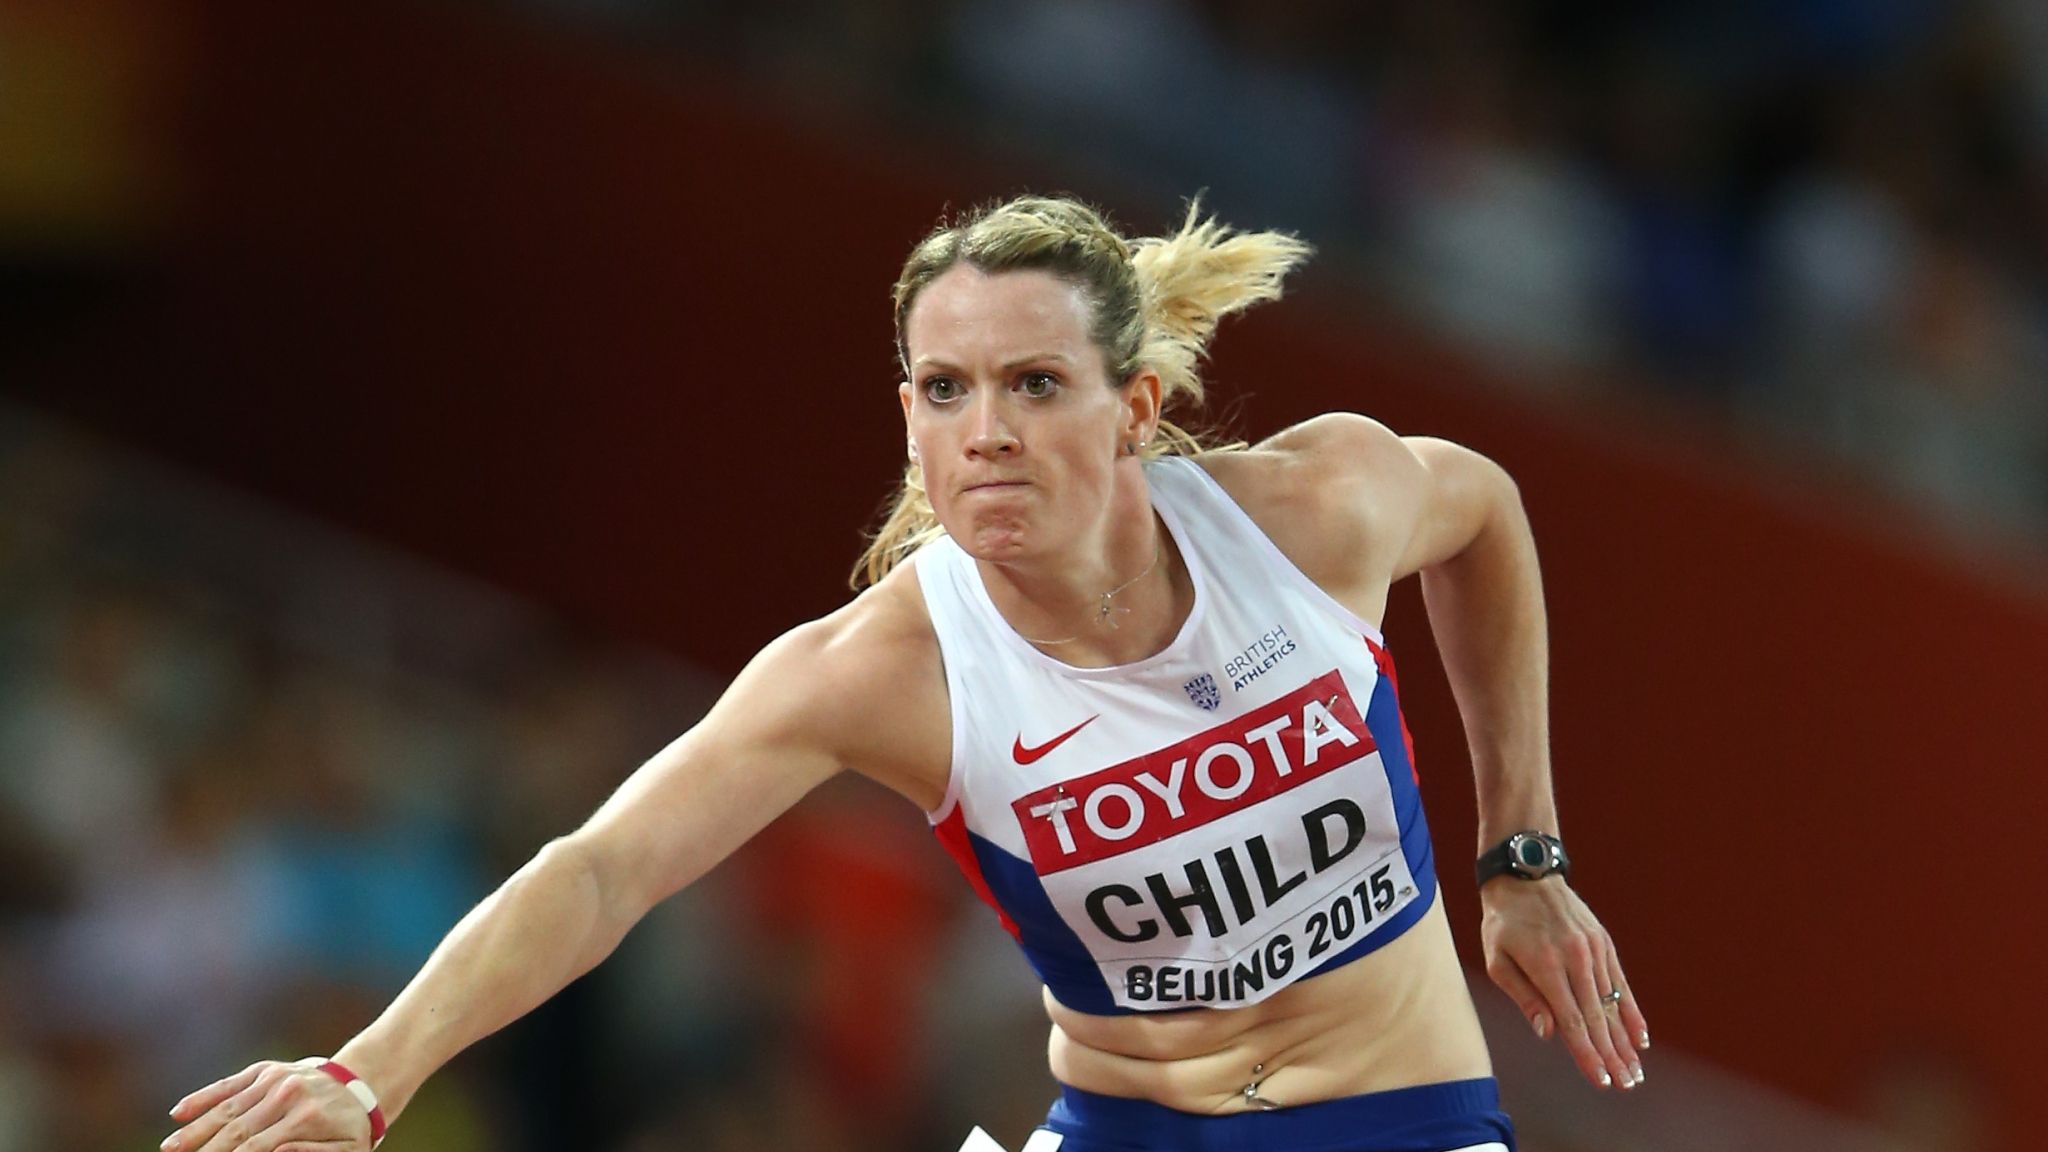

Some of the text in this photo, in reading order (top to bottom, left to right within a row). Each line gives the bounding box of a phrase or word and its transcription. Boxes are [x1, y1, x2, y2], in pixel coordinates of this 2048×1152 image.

[1225, 624, 1287, 678] BRITISH
[1233, 640, 1296, 692] ATHLETICS
[1030, 700, 1359, 855] TOYOTA
[1085, 799, 1366, 943] CHILD
[1126, 864, 1395, 1001] BEIJING 2015
